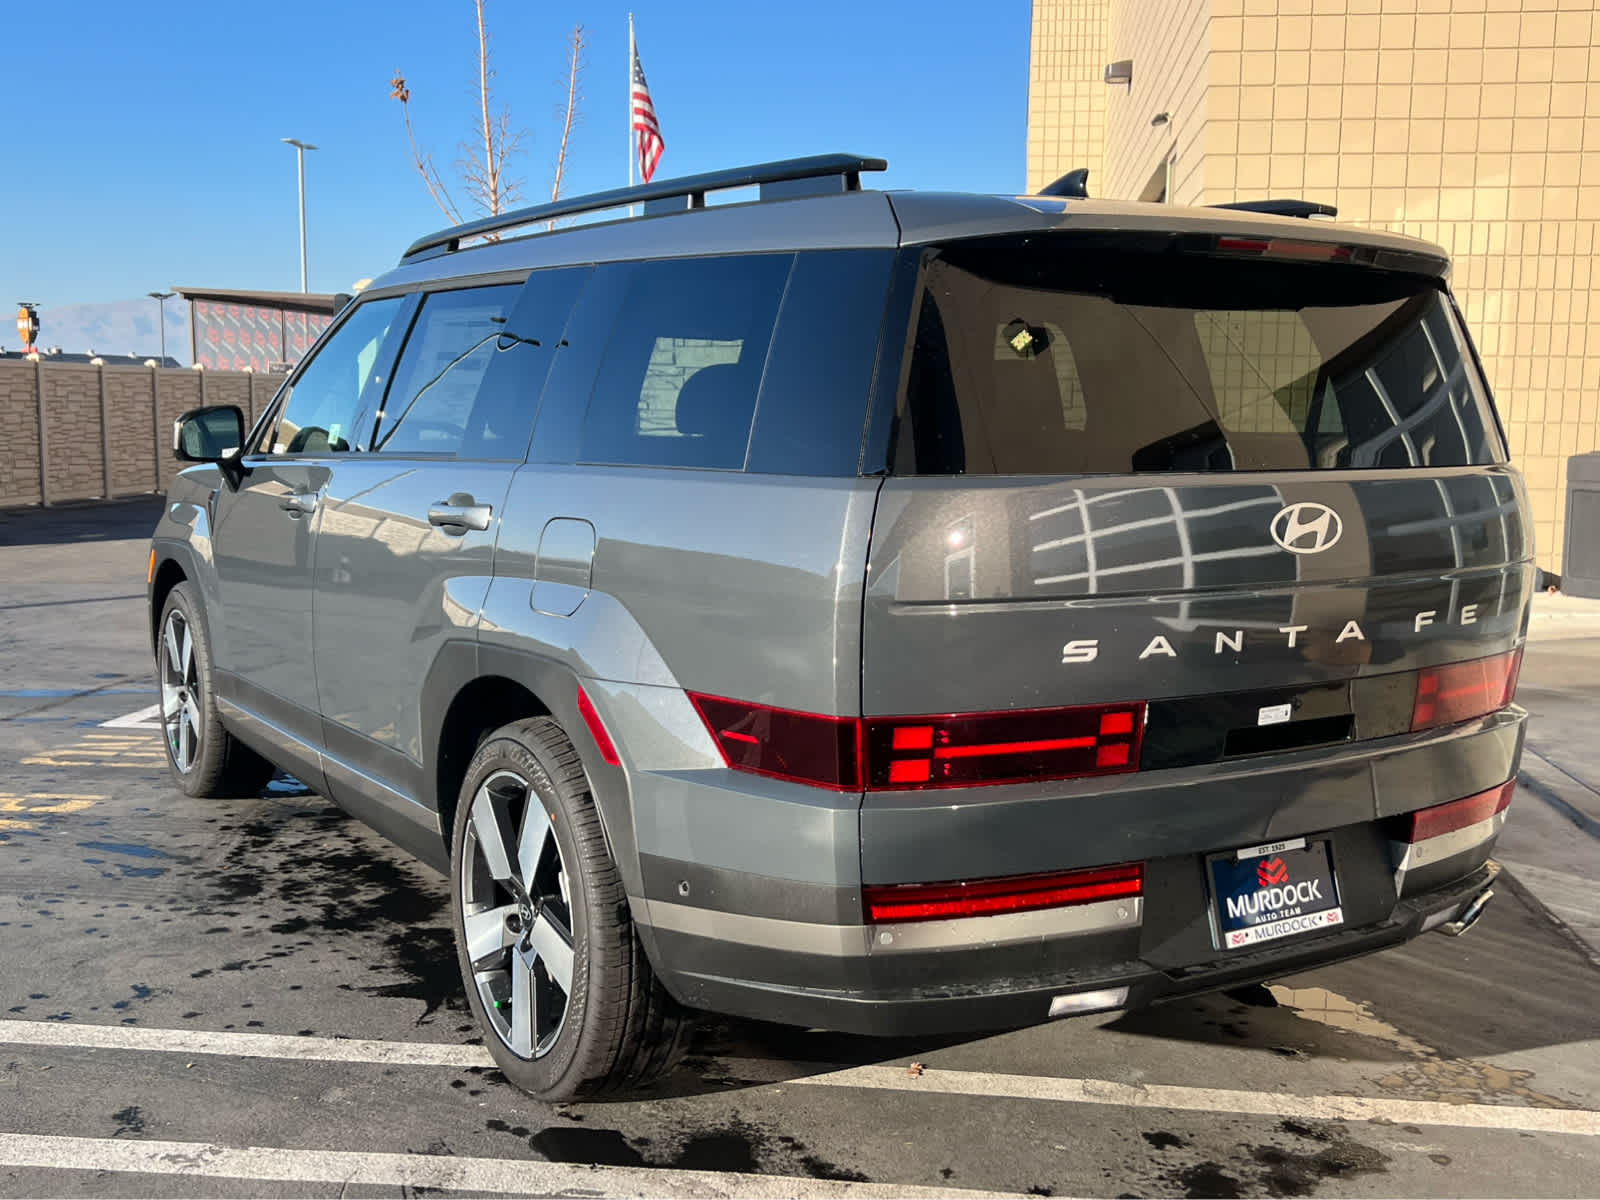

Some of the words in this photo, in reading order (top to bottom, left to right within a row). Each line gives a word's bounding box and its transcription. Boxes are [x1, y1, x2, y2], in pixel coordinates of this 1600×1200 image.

[1062, 620, 1365, 663] SANTA
[1415, 604, 1478, 632] FE
[1226, 879, 1322, 918] MURDOCK
[1254, 916, 1318, 940] MURDOCK
[1255, 913, 1277, 924] AUTO
[1280, 907, 1301, 917] TEAM
